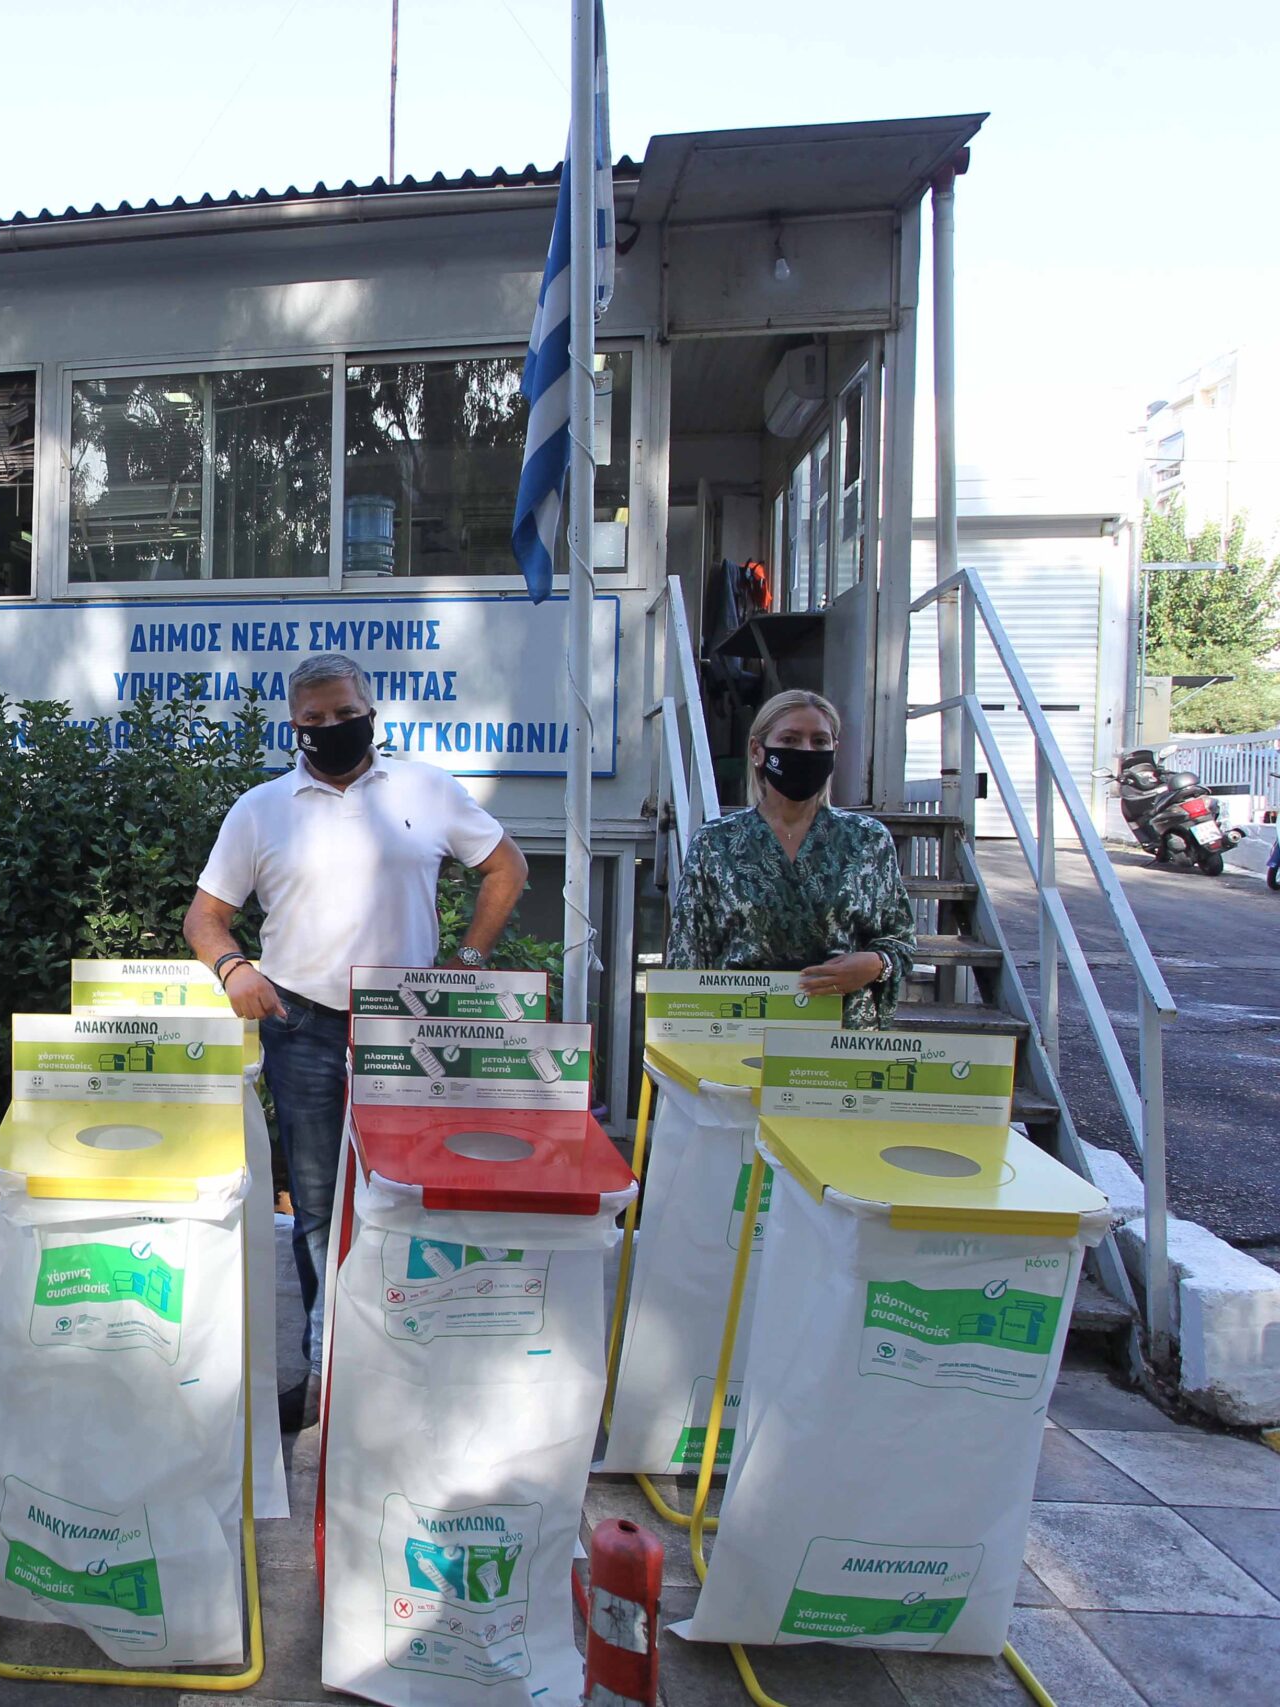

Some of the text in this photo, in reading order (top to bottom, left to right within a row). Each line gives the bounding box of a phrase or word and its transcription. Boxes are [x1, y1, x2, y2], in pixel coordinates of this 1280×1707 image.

[130, 620, 441, 652] ΔΗΜΟΣ ΝΕΑΣ ΣΜΥΡΝΗΣ
[121, 965, 190, 976] ΑΝΑΚΥΚΛΩΝΩ
[404, 972, 496, 993] ΑΝΑΚΥΚΛΩΝΩ μόνο
[699, 975, 790, 995] ΑΝΑΚΥΚΛΩΝΩ μόνο
[74, 1020, 181, 1046] ΑΝΑΚΥΚΛΩΝΩ μόνο
[417, 1024, 528, 1049] ΑΝΑΚΥΚΛΩΝΩ μόνο
[830, 1035, 947, 1065] ΑΝΑΚΥΚΛΩΝΩ μόνο
[1024, 1255, 1060, 1273] μόνο
[46, 1266, 91, 1286] χάρτινες
[46, 1281, 111, 1299] συσκευασίες
[873, 1291, 930, 1322] χάρτινες
[871, 1308, 951, 1338] συσκευασίες
[27, 1504, 120, 1541] ΑΝΑΚΥΚΛΩΝΩ
[841, 1556, 949, 1576] ΑΝΑΚΥΚΛΩΝΩ
[797, 1607, 848, 1623] χάρτινες
[793, 1620, 867, 1635] συσκευασίες
